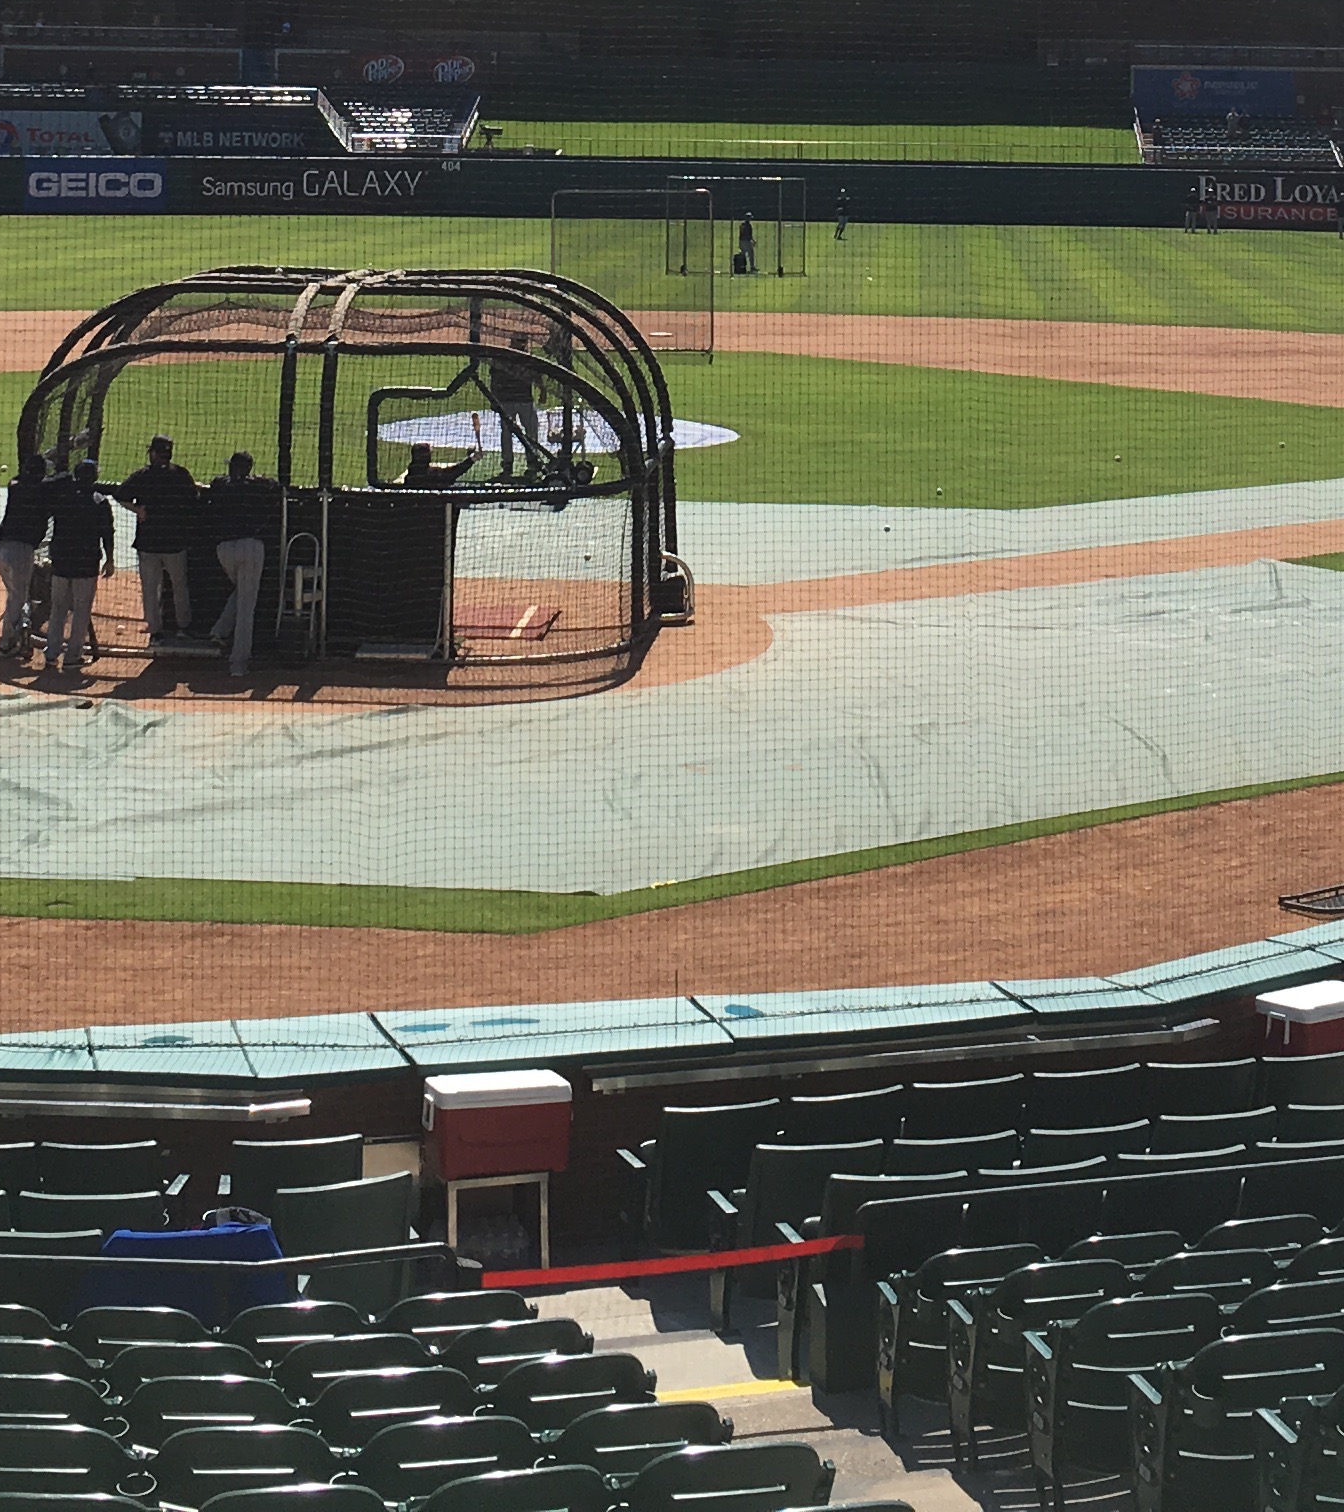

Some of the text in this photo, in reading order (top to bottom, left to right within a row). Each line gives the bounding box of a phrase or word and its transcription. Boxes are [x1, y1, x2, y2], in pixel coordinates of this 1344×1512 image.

[25, 127, 96, 144] TOTAL
[176, 131, 305, 149] MLB NETWORK
[441, 161, 461, 172] 404
[28, 170, 164, 199] GEICO
[202, 168, 420, 200] Samsung GALAXY
[1198, 174, 1340, 204] FRED LOYA
[1199, 206, 1338, 223] SURANCE
